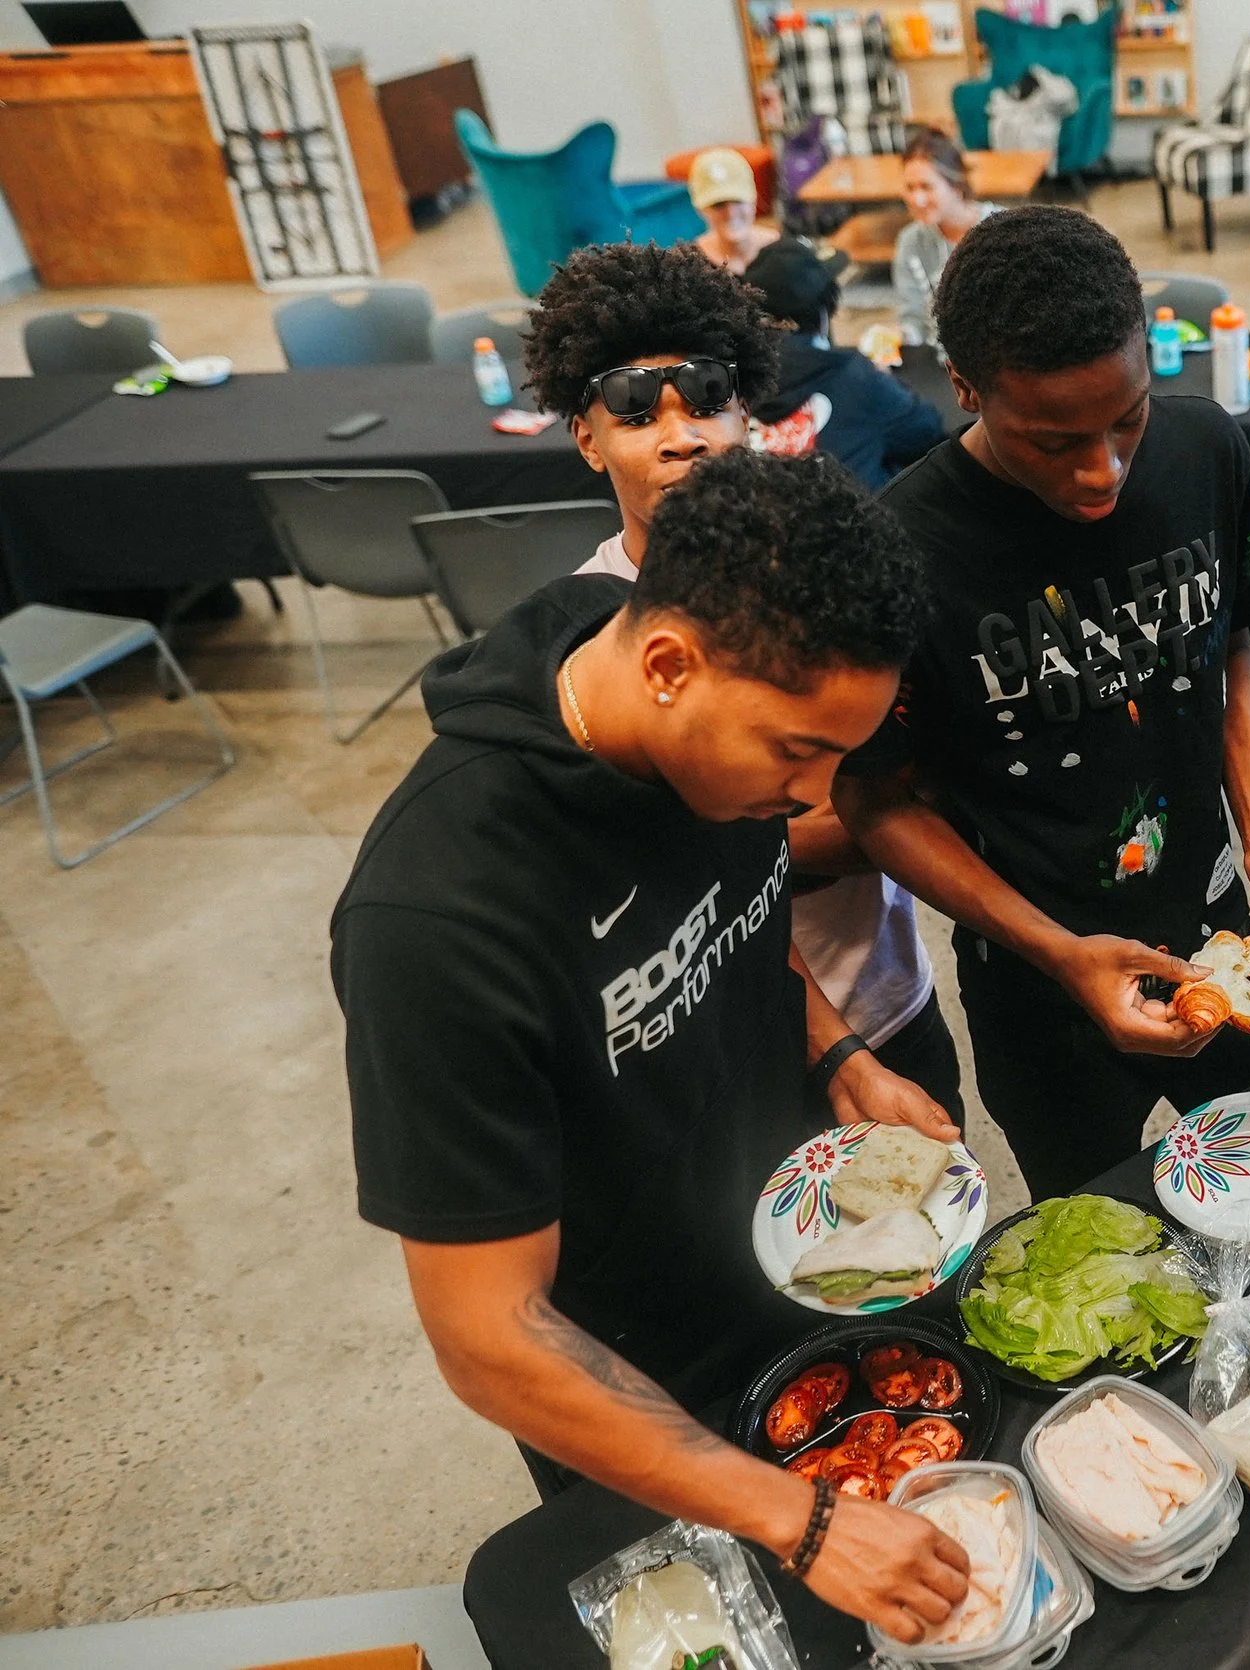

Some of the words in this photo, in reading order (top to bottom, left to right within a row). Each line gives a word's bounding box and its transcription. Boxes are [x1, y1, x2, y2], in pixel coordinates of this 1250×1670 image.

[977, 530, 1216, 678] GALLERY
[601, 880, 722, 1032] BOOST
[607, 839, 790, 1078] Performance
[1208, 1188, 1219, 1203] SOLO
